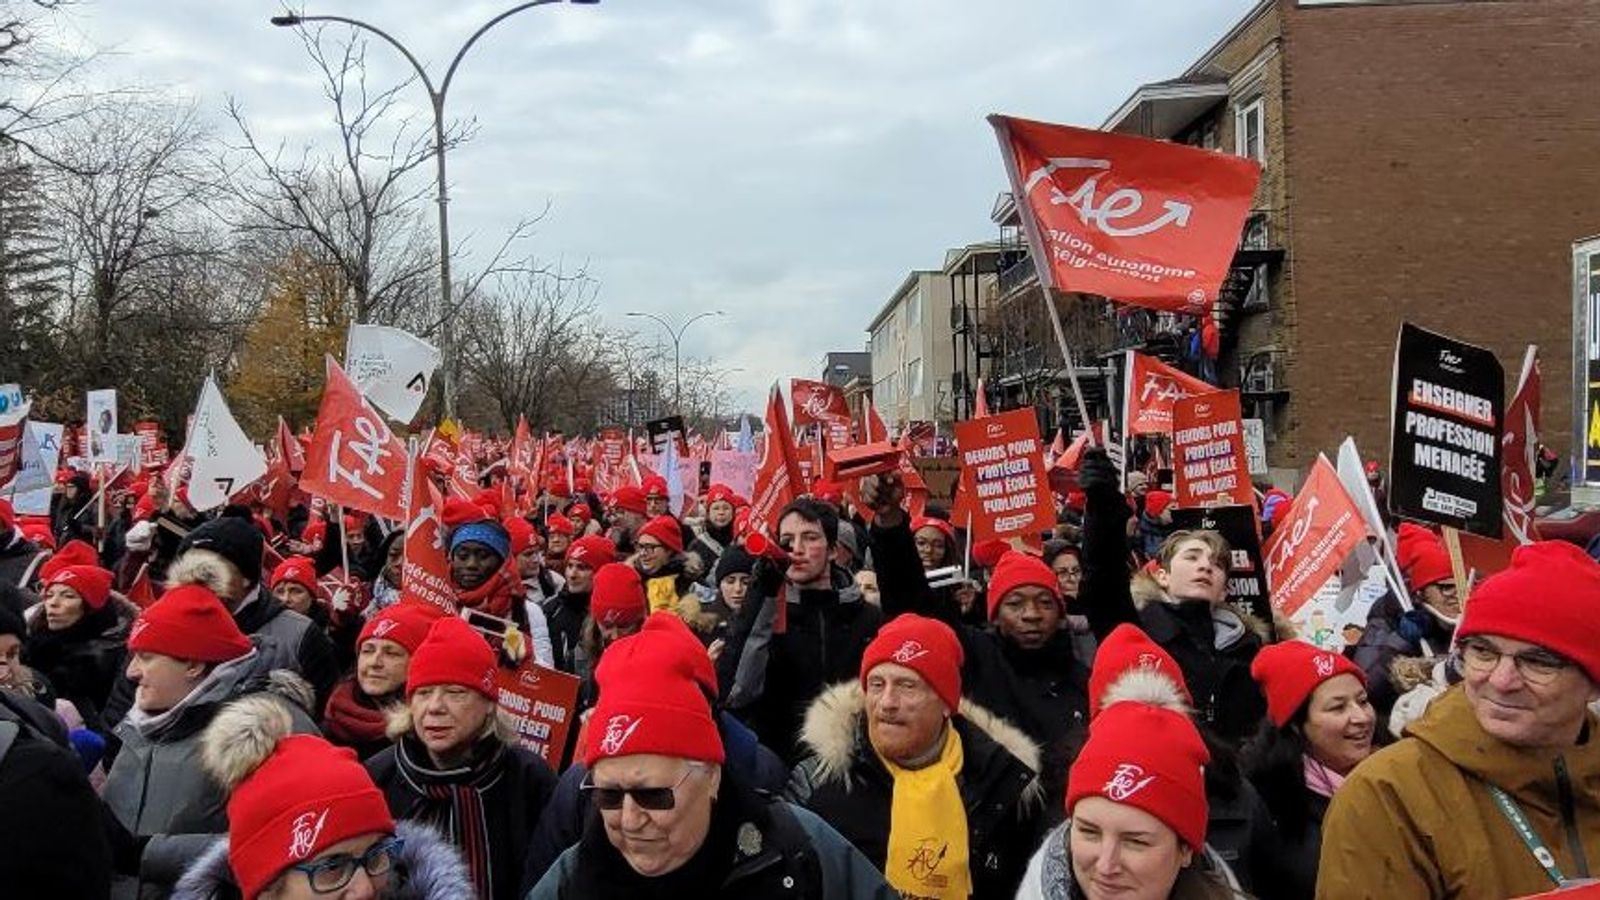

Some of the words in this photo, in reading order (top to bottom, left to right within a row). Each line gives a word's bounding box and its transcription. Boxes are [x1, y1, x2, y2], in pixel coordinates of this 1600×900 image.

[1098, 251, 1197, 280] autonome
[1412, 378, 1493, 422] ENSEIGNER
[1213, 420, 1239, 437] POUR
[1405, 411, 1495, 457] PROFESSION
[964, 444, 1007, 465] DEHORS
[1008, 439, 1037, 455] POUR
[1414, 443, 1487, 483] MENACÉE
[977, 458, 1031, 481] PROTÉGER
[1183, 463, 1209, 480] MON
[1210, 455, 1237, 474] ÉCOLE
[976, 481, 1003, 498] MON
[1005, 474, 1038, 492] ÉCOLE
[498, 687, 531, 713] EHORS
[533, 700, 567, 723] POUR
